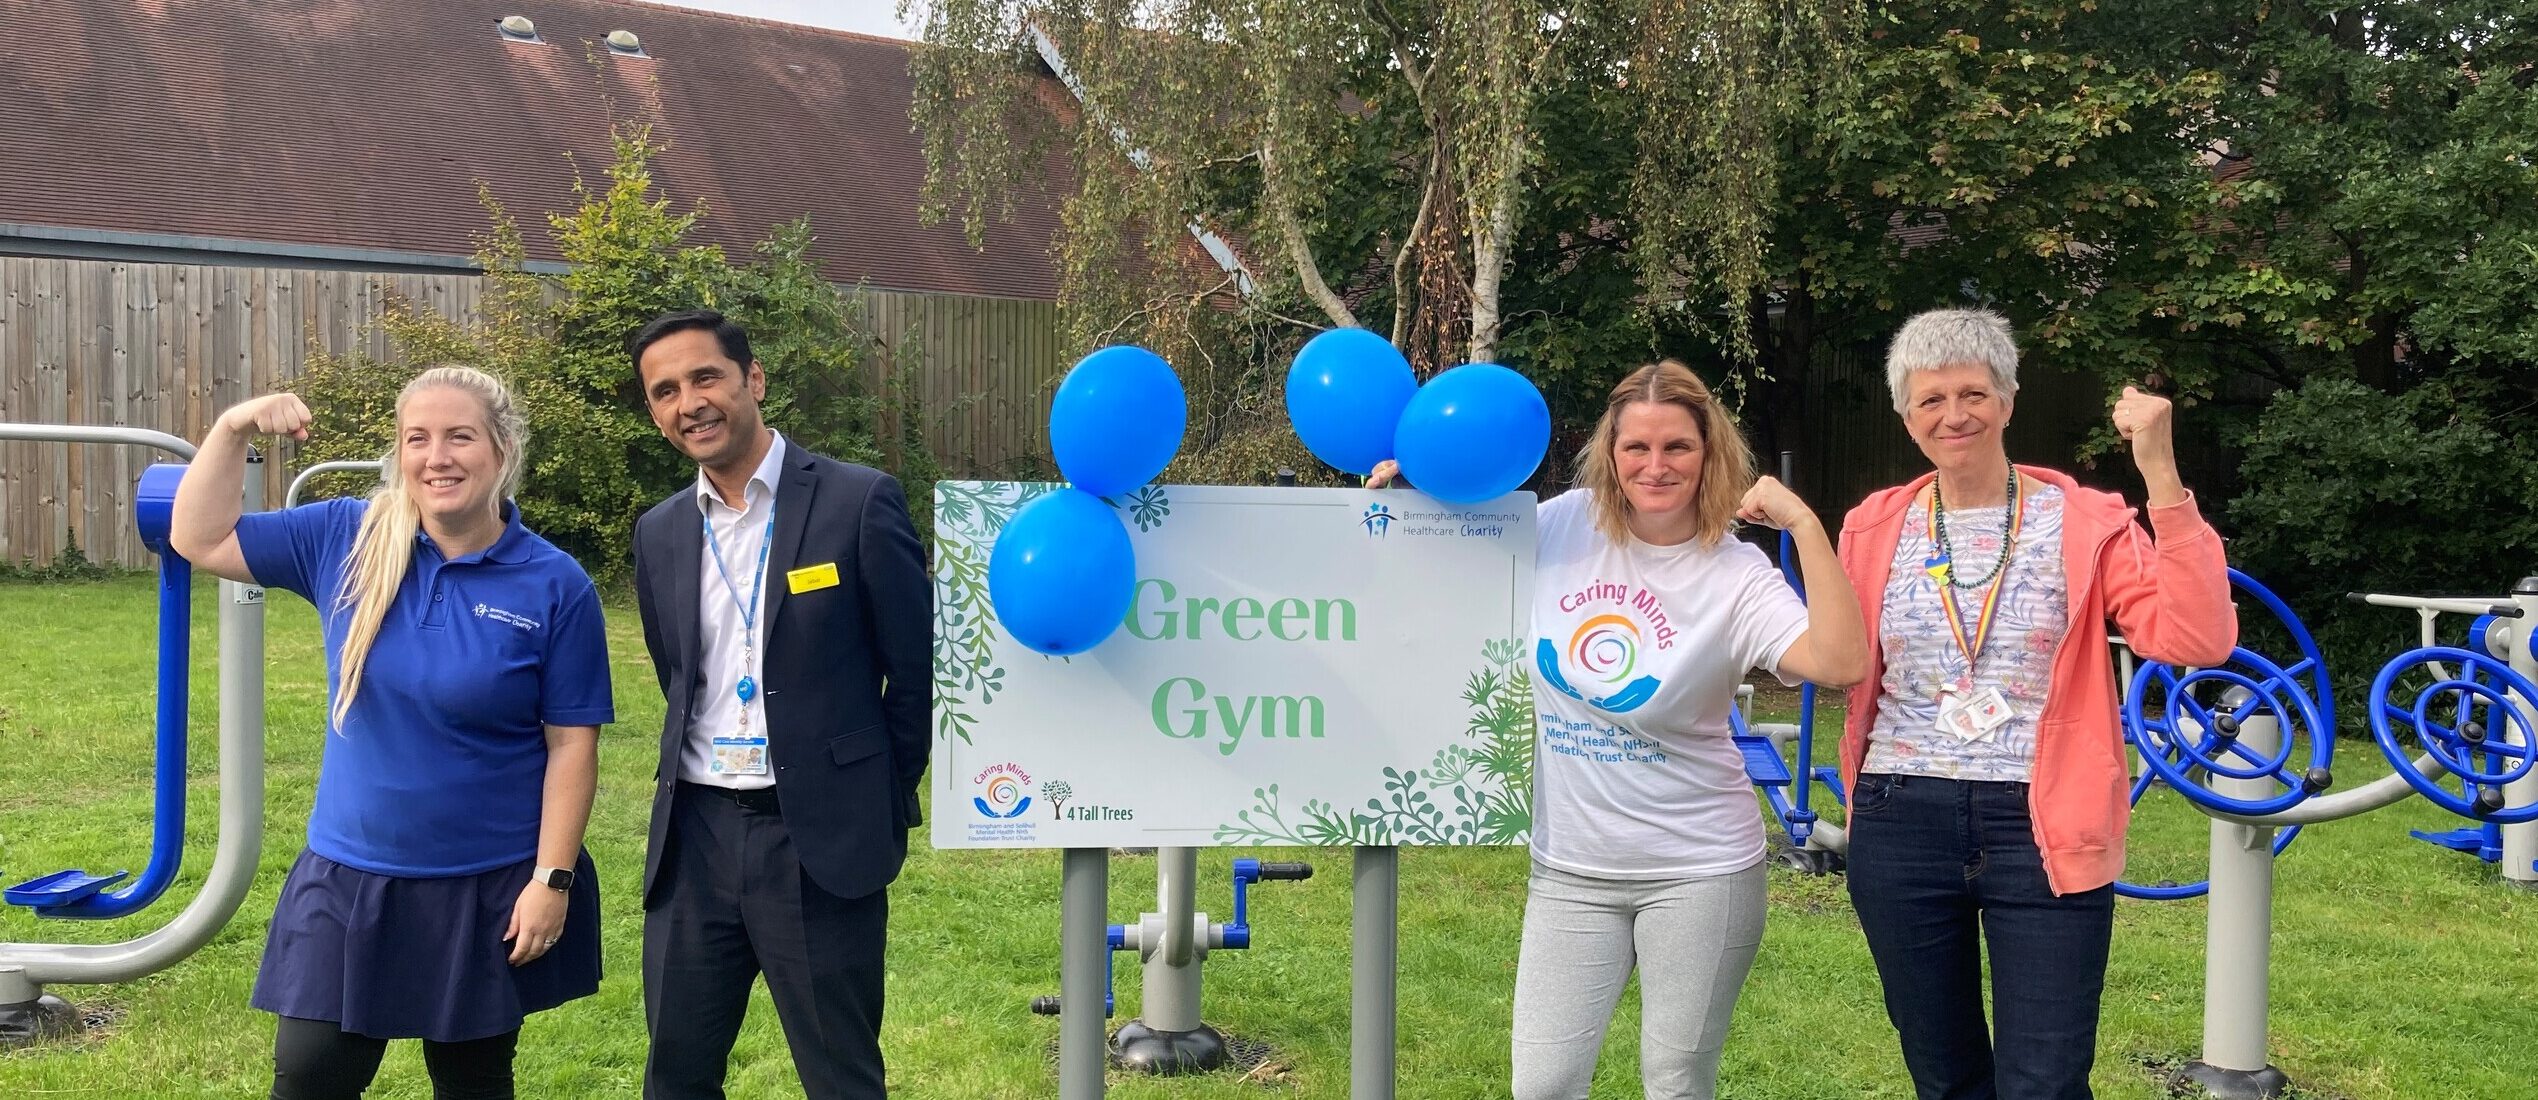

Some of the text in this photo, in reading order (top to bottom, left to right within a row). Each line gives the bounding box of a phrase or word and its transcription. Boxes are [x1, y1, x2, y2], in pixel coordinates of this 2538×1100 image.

[1403, 511, 1520, 523] Birmingham Community
[1403, 525, 1503, 539] Healthcare Charity
[1124, 578, 1357, 641] Green
[1559, 579, 1678, 650] Caring Minds
[1151, 677, 1326, 756] Gym
[1541, 712, 1592, 731] rmiham
[1546, 727, 1579, 746] Menl
[1593, 752, 1623, 763] Trust
[974, 762, 1032, 786] Caring Minds
[1067, 805, 1133, 820] 4 Tall Trees
